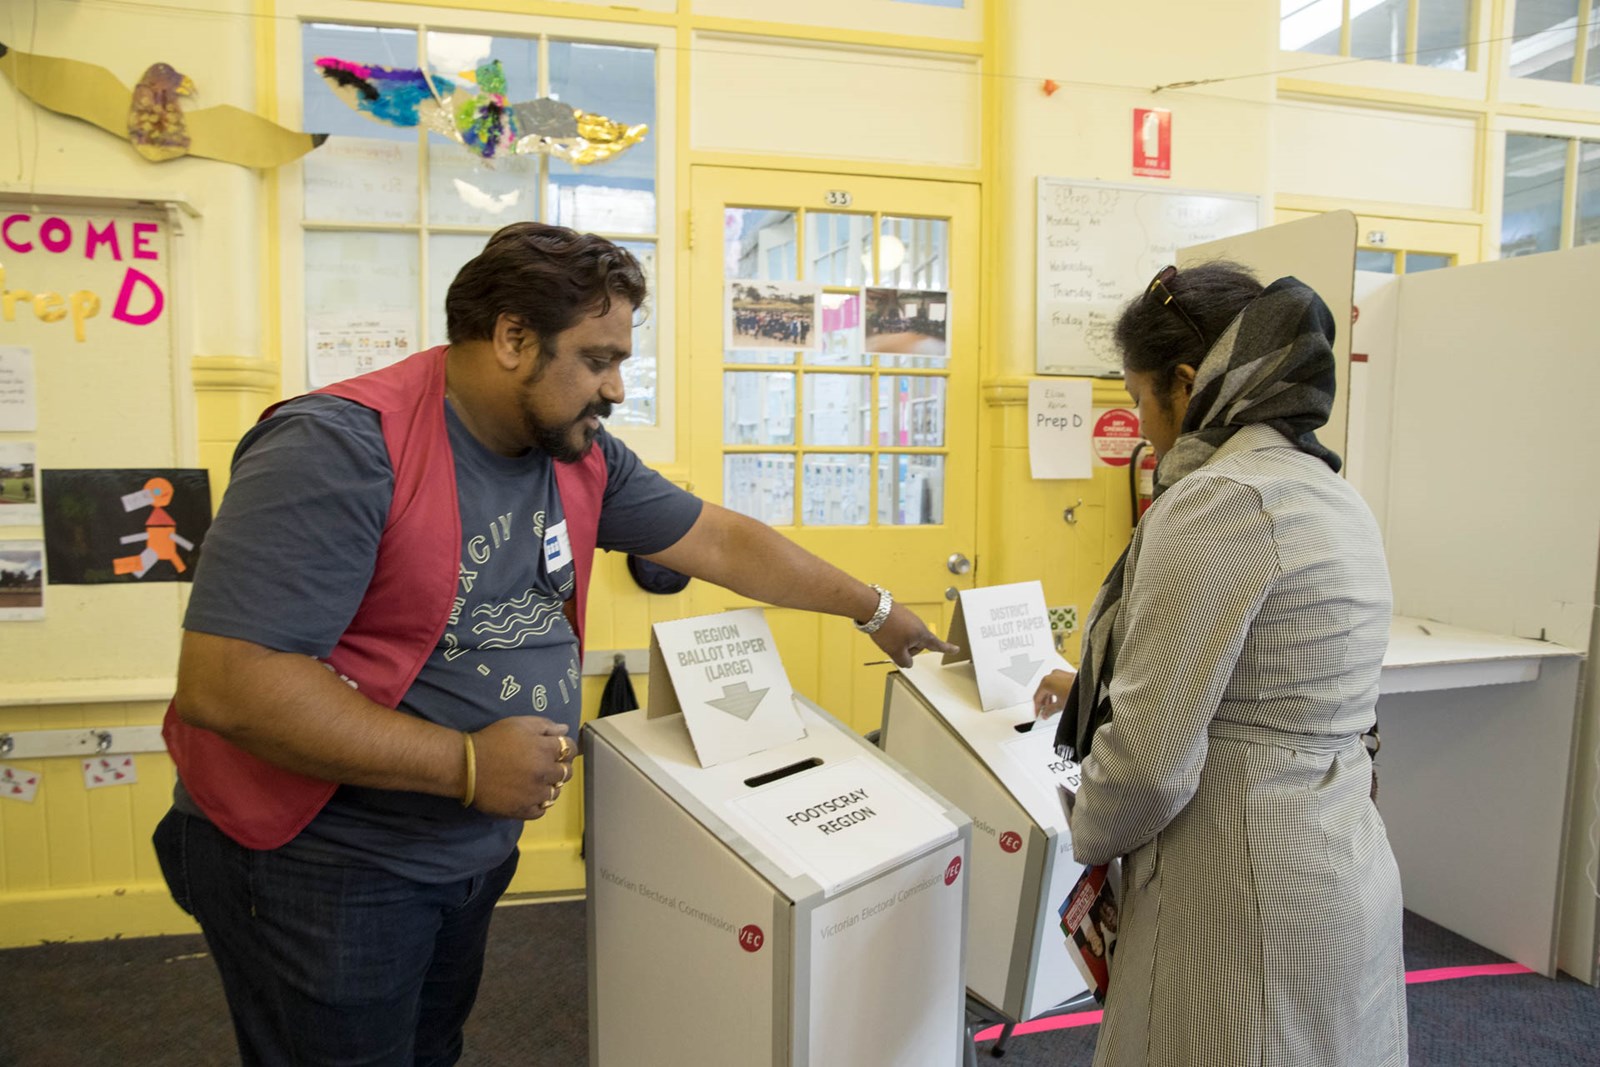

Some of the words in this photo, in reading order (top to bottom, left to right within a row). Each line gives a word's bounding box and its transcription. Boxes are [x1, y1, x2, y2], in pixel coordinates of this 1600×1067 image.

[829, 191, 848, 205] 33
[0, 263, 101, 343] rep
[111, 266, 164, 326] D
[1051, 310, 1083, 332] Friday
[1036, 413, 1068, 432] Prep
[1072, 413, 1083, 428] D
[989, 603, 1029, 621] DISTRICT
[693, 624, 740, 645] REGION
[980, 620, 1014, 639] BALLOT
[1016, 616, 1045, 633] PAPER
[677, 645, 726, 667] BALLOT
[728, 637, 767, 658] PAPER
[998, 633, 1035, 654] (SMALL)
[705, 658, 753, 682] (LARGE)
[786, 788, 869, 826] FOOTSCRAY
[817, 806, 877, 836] REGION
[972, 816, 996, 837] ission
[599, 867, 638, 892] Victorian
[639, 884, 677, 909] Electoral
[678, 900, 737, 935] Commission
[820, 914, 860, 940] Victorian
[861, 895, 897, 921] Electoral
[897, 873, 943, 903] Commission
